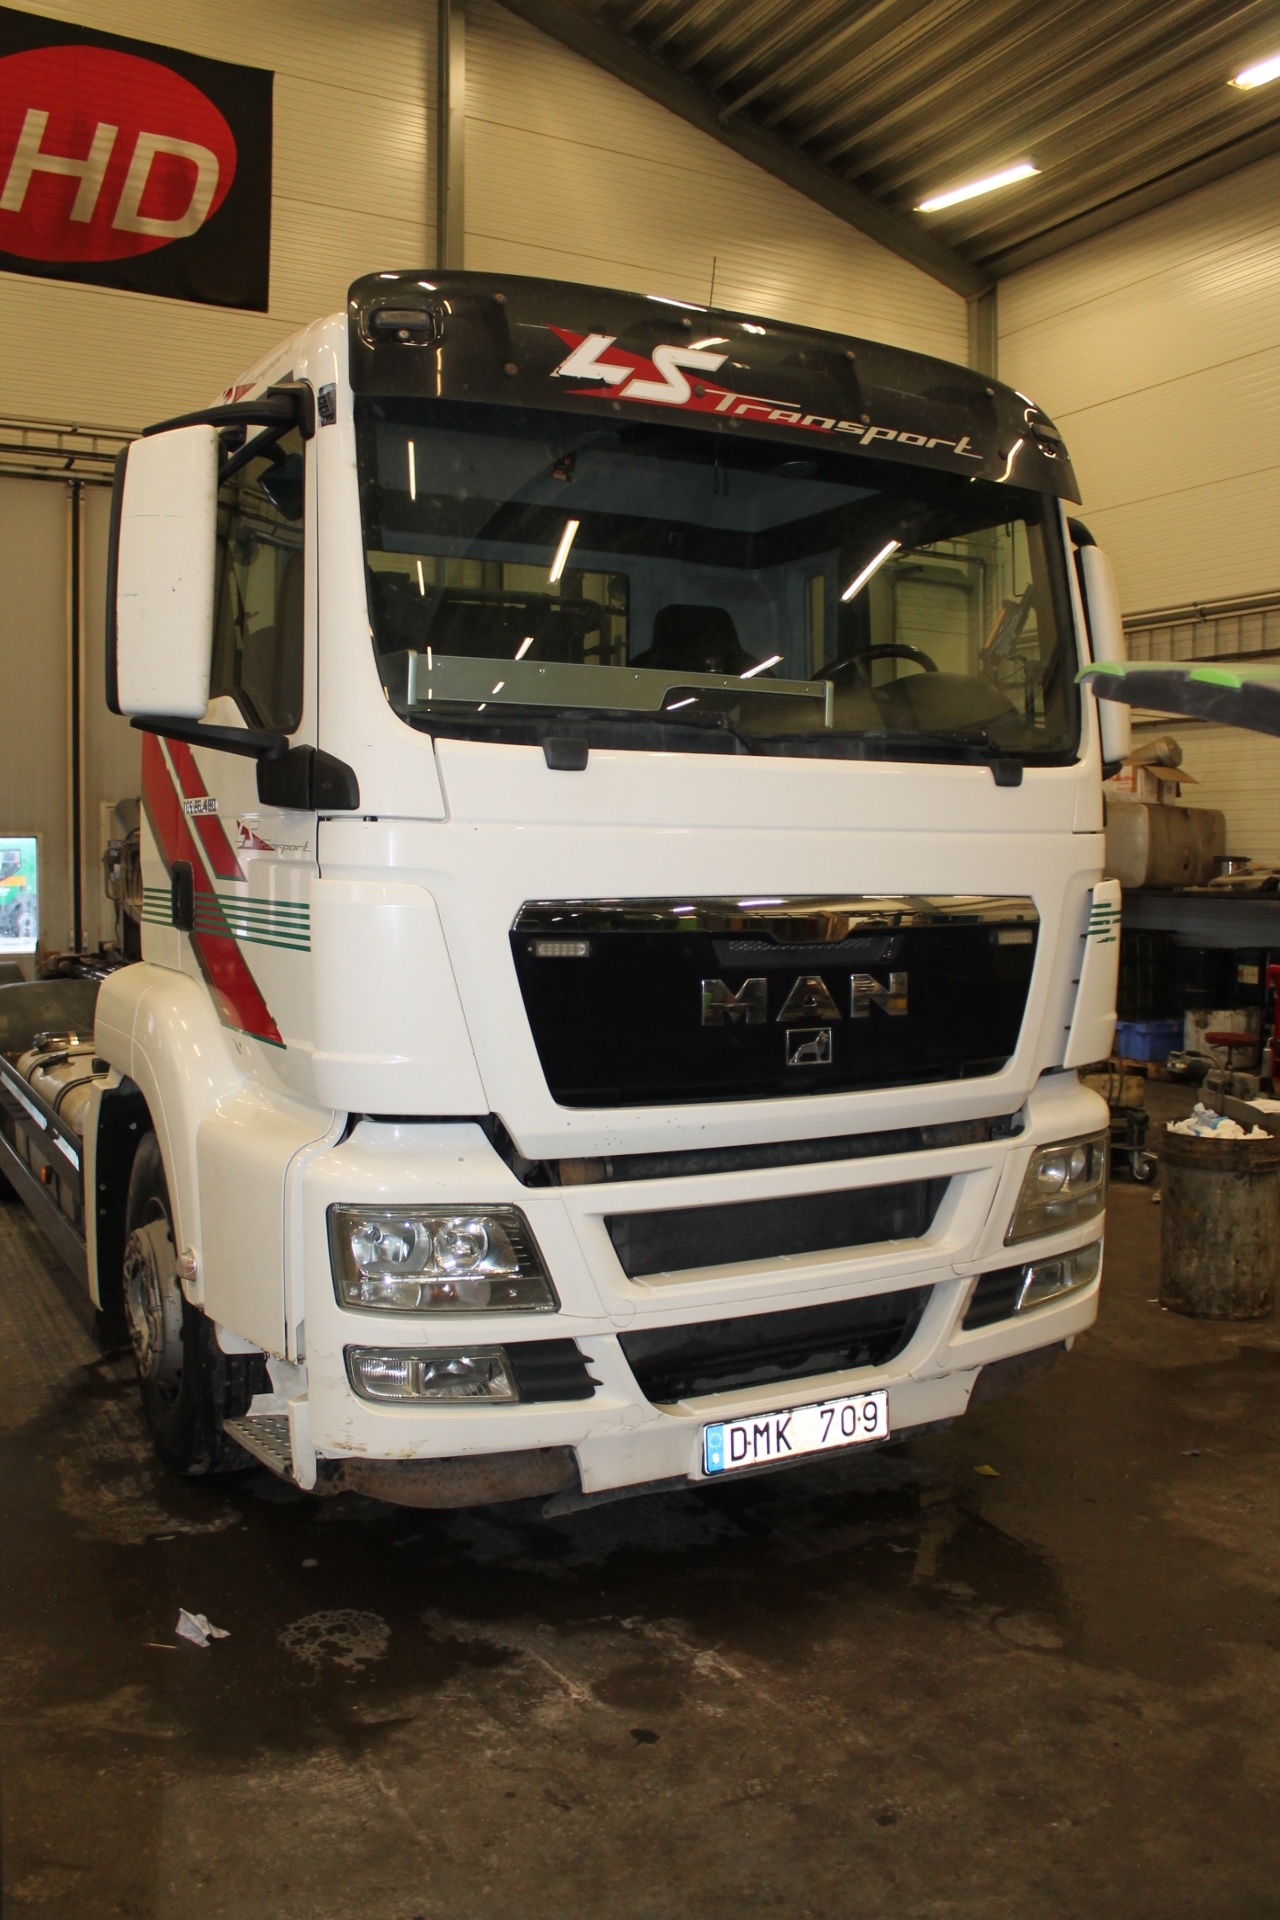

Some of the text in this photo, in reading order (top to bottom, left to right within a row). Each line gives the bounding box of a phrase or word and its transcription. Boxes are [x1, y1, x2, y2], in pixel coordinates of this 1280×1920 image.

[0, 108, 220, 238] HD
[549, 333, 984, 459] LS Transport
[702, 972, 908, 1025] MAN
[730, 1417, 793, 1462] DMK
[820, 1401, 878, 1443] 709
